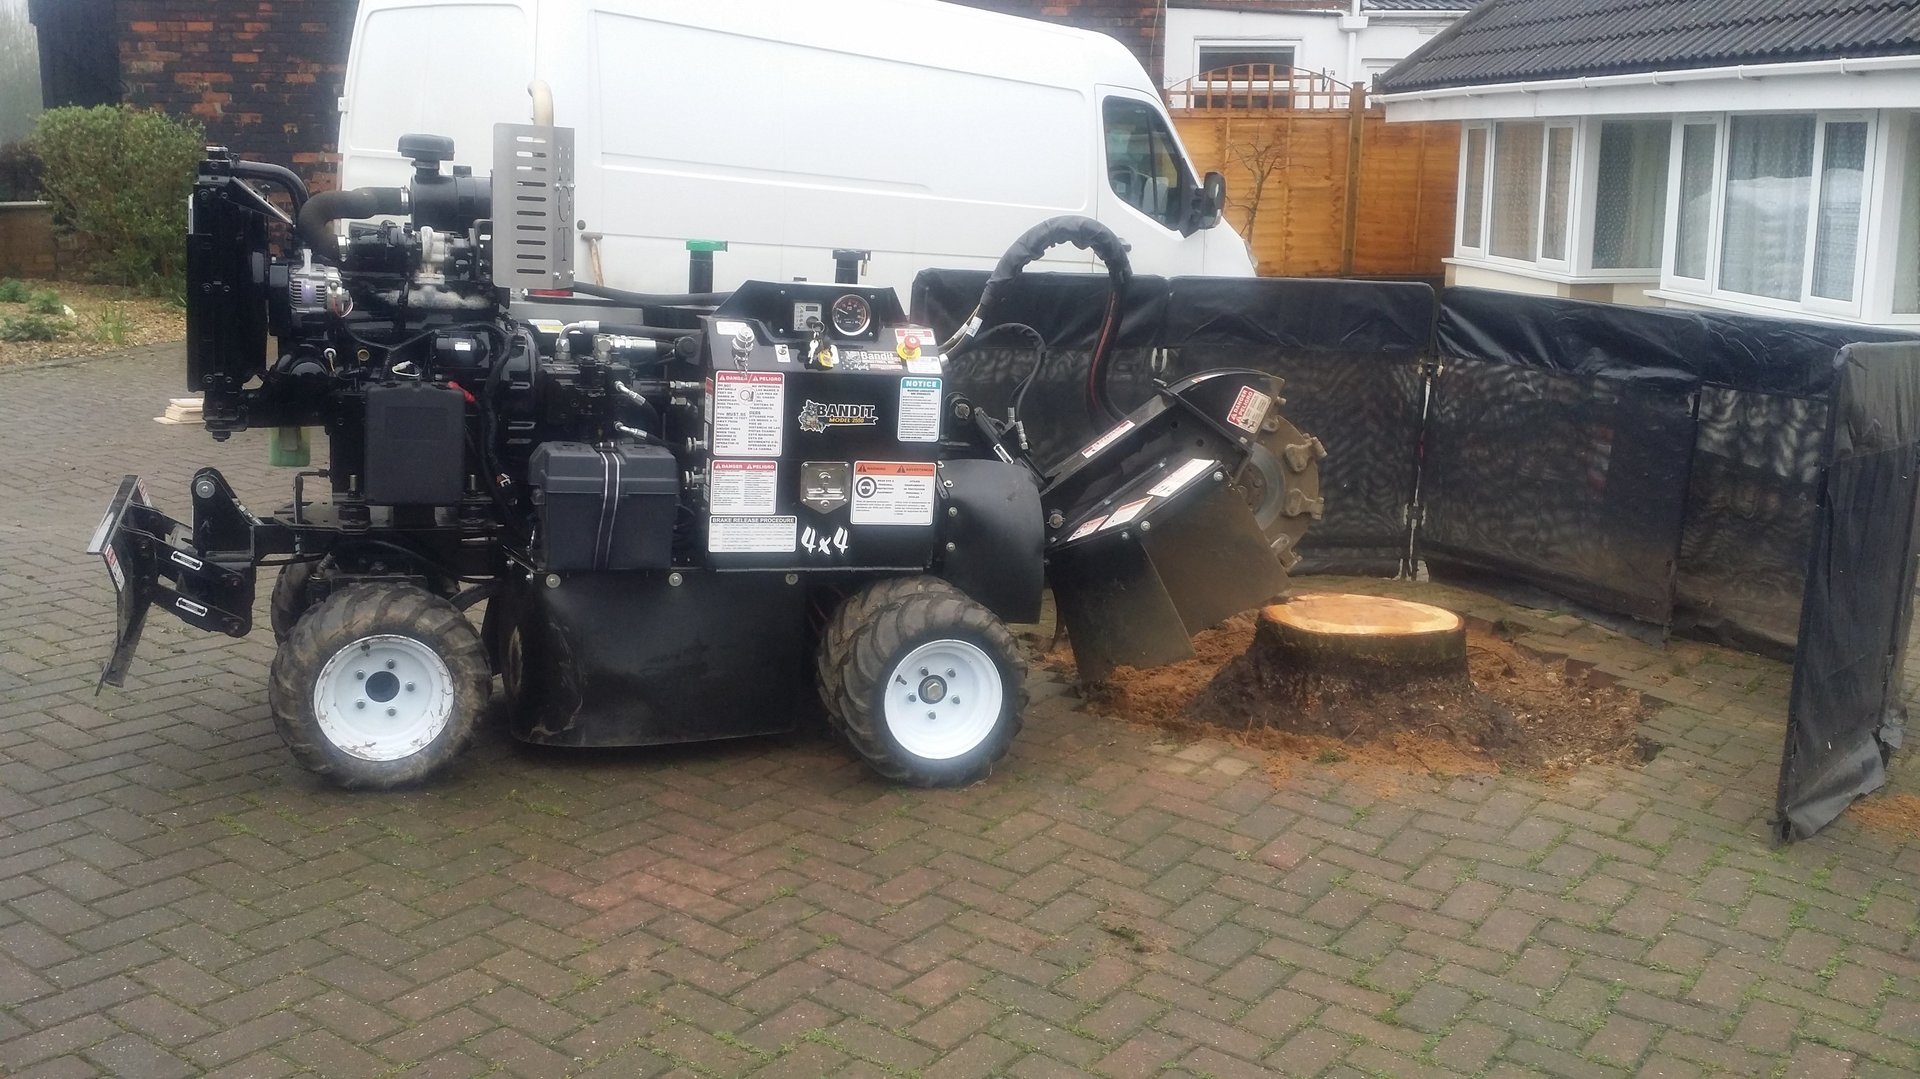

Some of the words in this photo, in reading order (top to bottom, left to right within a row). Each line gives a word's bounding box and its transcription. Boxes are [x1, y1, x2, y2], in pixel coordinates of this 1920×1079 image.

[860, 351, 894, 362] Bandit
[905, 380, 937, 388] NOTICE
[816, 404, 875, 418] BANDIT
[1233, 389, 1248, 414] DANGER
[1238, 391, 1253, 416] PELIGRO
[801, 526, 848, 555] 4x4
